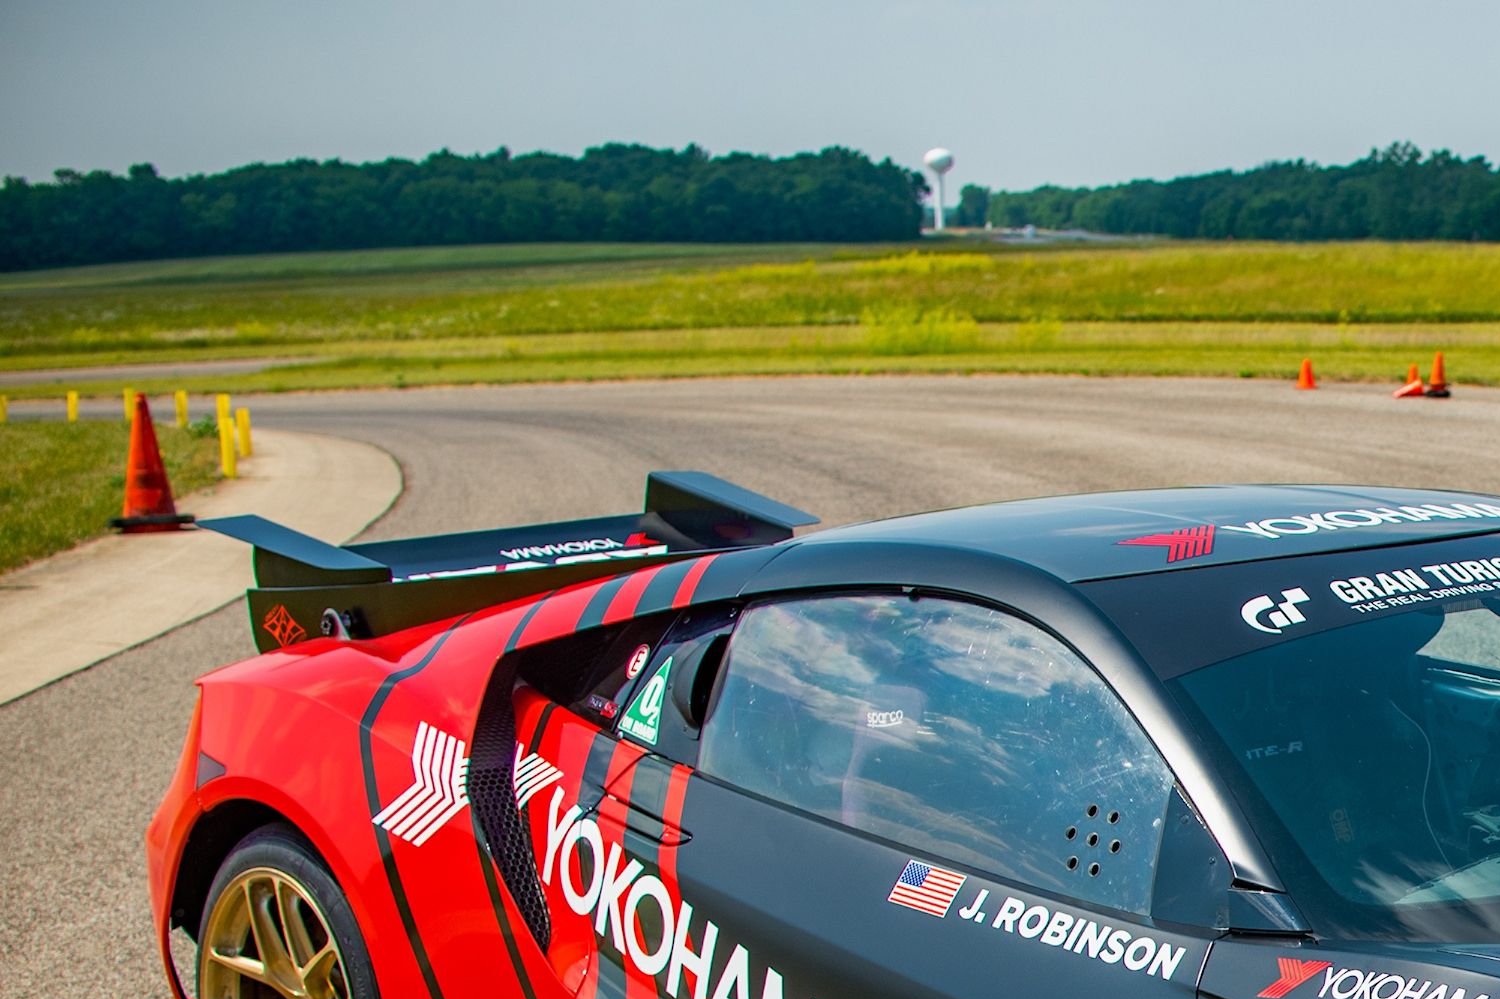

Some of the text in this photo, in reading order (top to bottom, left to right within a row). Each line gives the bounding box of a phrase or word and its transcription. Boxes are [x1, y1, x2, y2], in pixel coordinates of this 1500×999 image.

[500, 538, 623, 560] YOKOHAMA
[1329, 568, 1431, 604] GRAN
[1351, 599, 1389, 614] THE
[1387, 593, 1432, 607] REAL
[1431, 583, 1496, 601] DRIVING
[631, 650, 645, 672] E
[867, 709, 903, 728] sparco
[959, 889, 1187, 981] J. ROBINSON
